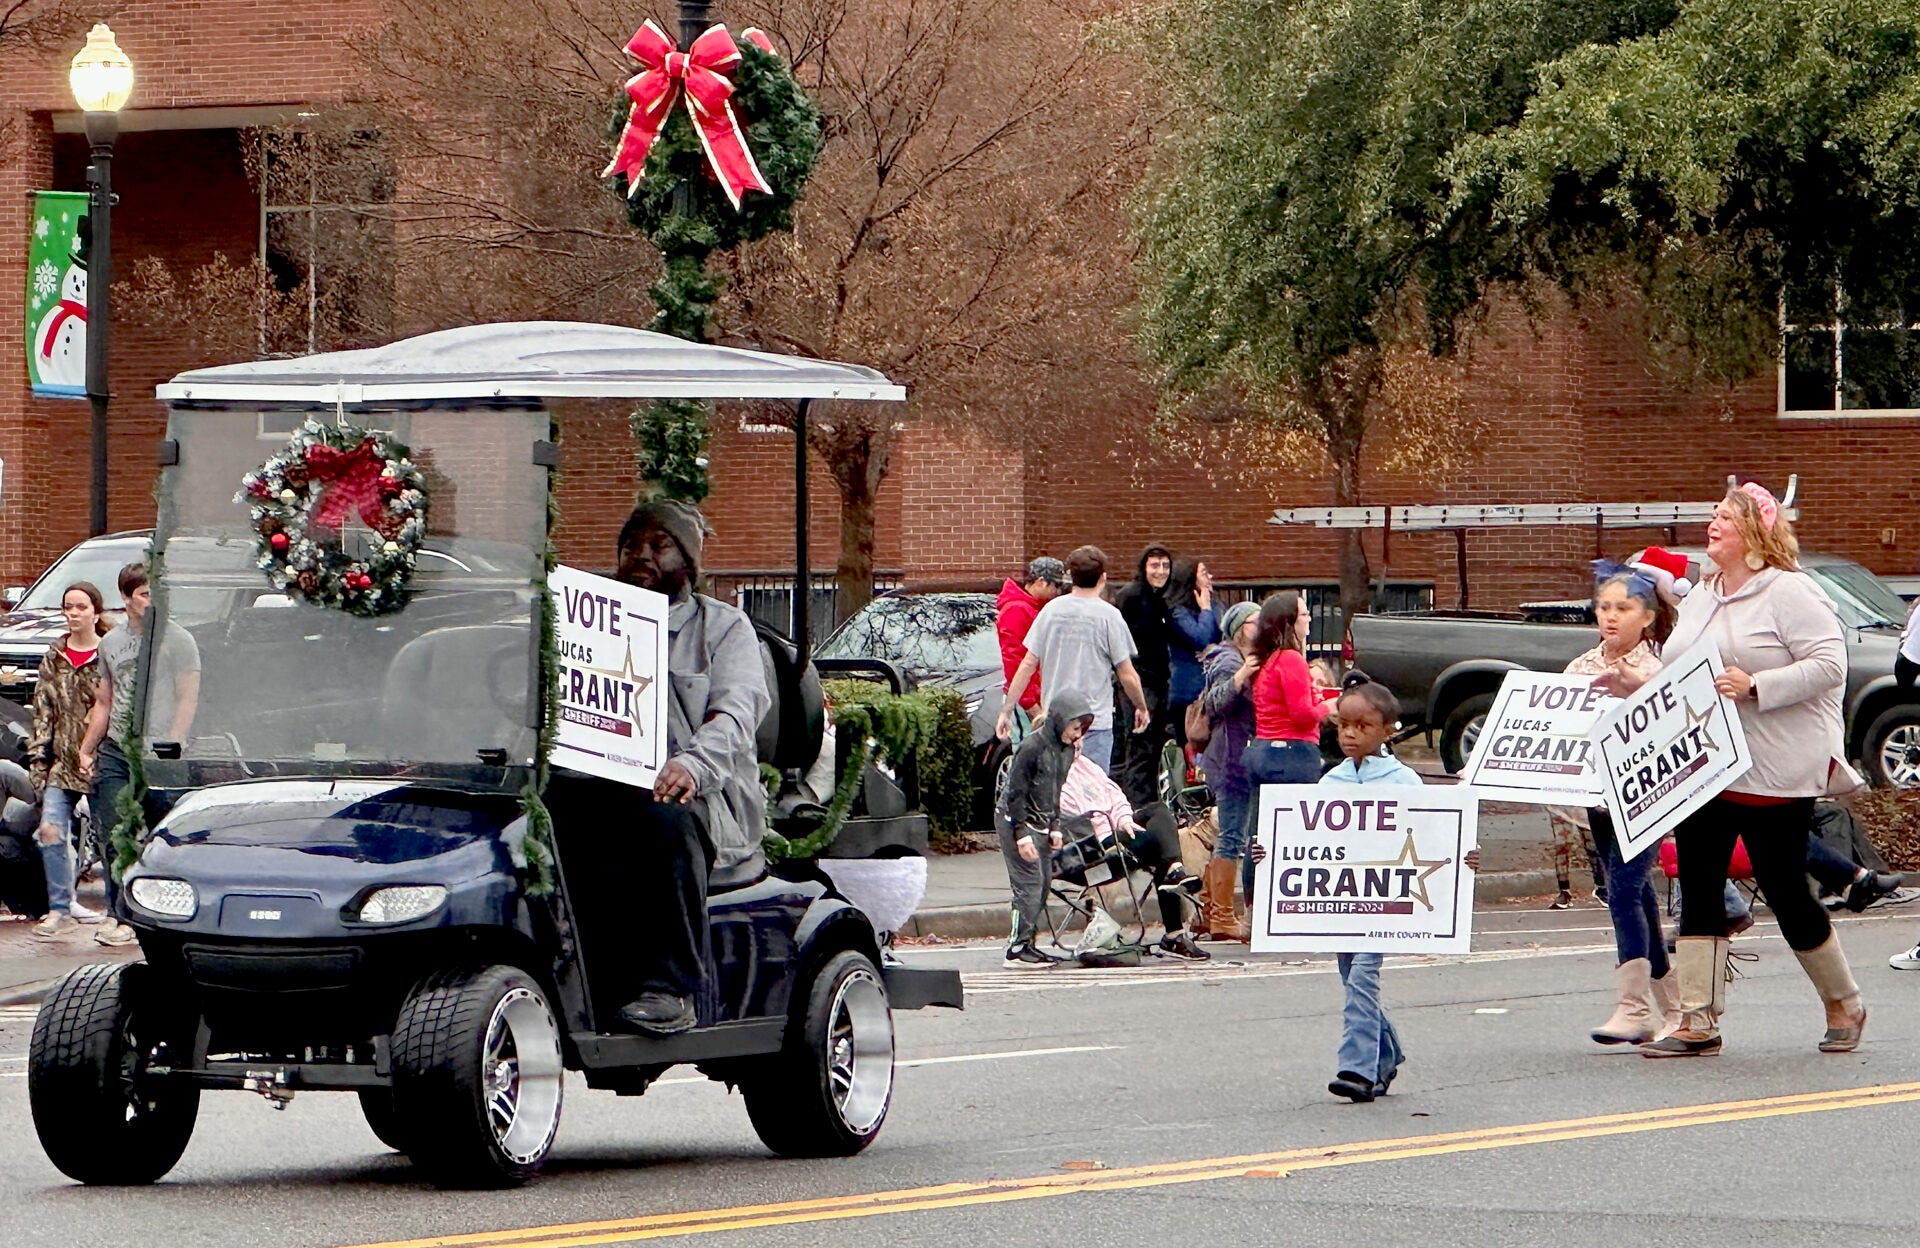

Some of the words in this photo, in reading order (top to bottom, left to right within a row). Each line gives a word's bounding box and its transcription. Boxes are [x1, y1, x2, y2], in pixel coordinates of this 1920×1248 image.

[564, 585, 622, 637] VOTE
[559, 640, 593, 664] UCAS
[1528, 684, 1599, 712] VOTE
[1503, 718, 1552, 732] LUCAS
[1614, 681, 1678, 745] VOTE
[1492, 735, 1591, 763] GRANT
[1616, 740, 1656, 778] LUCAS
[1622, 725, 1703, 805] GRANT
[1299, 799, 1398, 832] VOTE
[1282, 846, 1346, 861] LUCAS
[1279, 867, 1418, 898] GRANT
[1281, 902, 1295, 913] for
[1297, 902, 1357, 913] SHERIFF
[1357, 902, 1384, 913] 2024
[1396, 931, 1432, 939] COUNTY
